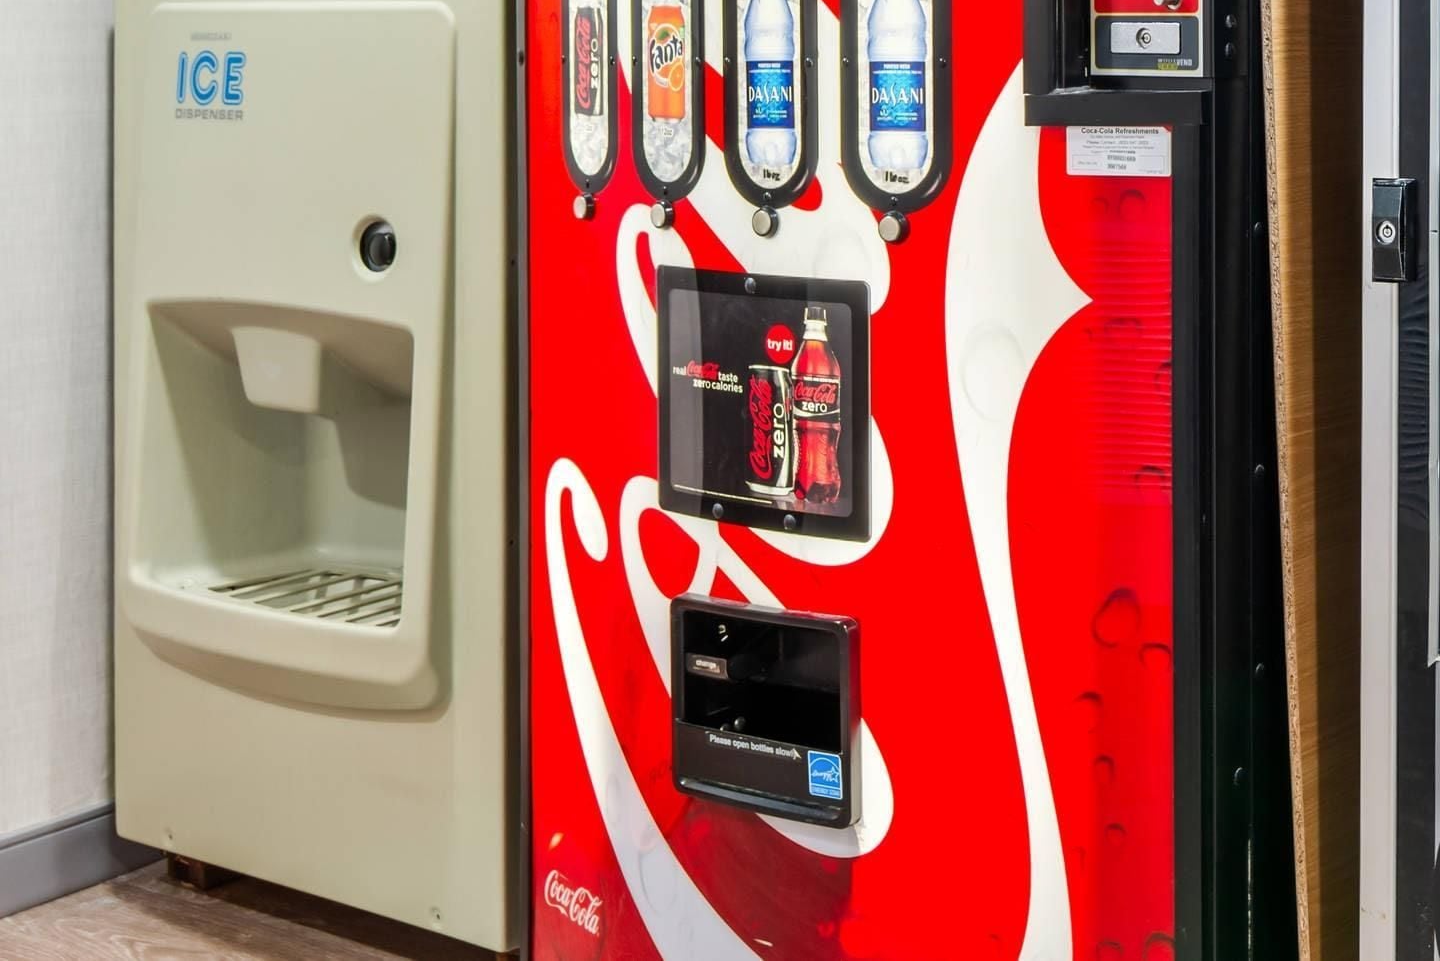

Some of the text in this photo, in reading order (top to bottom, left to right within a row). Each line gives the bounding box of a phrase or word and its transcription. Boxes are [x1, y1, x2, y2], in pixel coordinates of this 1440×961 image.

[591, 38, 599, 90] zero
[649, 34, 683, 74] Fanta
[176, 50, 247, 106] ICE
[748, 81, 793, 104] DASANI
[871, 82, 924, 107] DASANI
[175, 108, 244, 121] DISPENSER
[767, 339, 793, 352] try it!
[672, 365, 738, 383] real taste
[693, 378, 744, 394] zero calories
[801, 401, 828, 413] zero
[773, 402, 785, 459] zero
[709, 733, 798, 761] Please open bottles slowly
